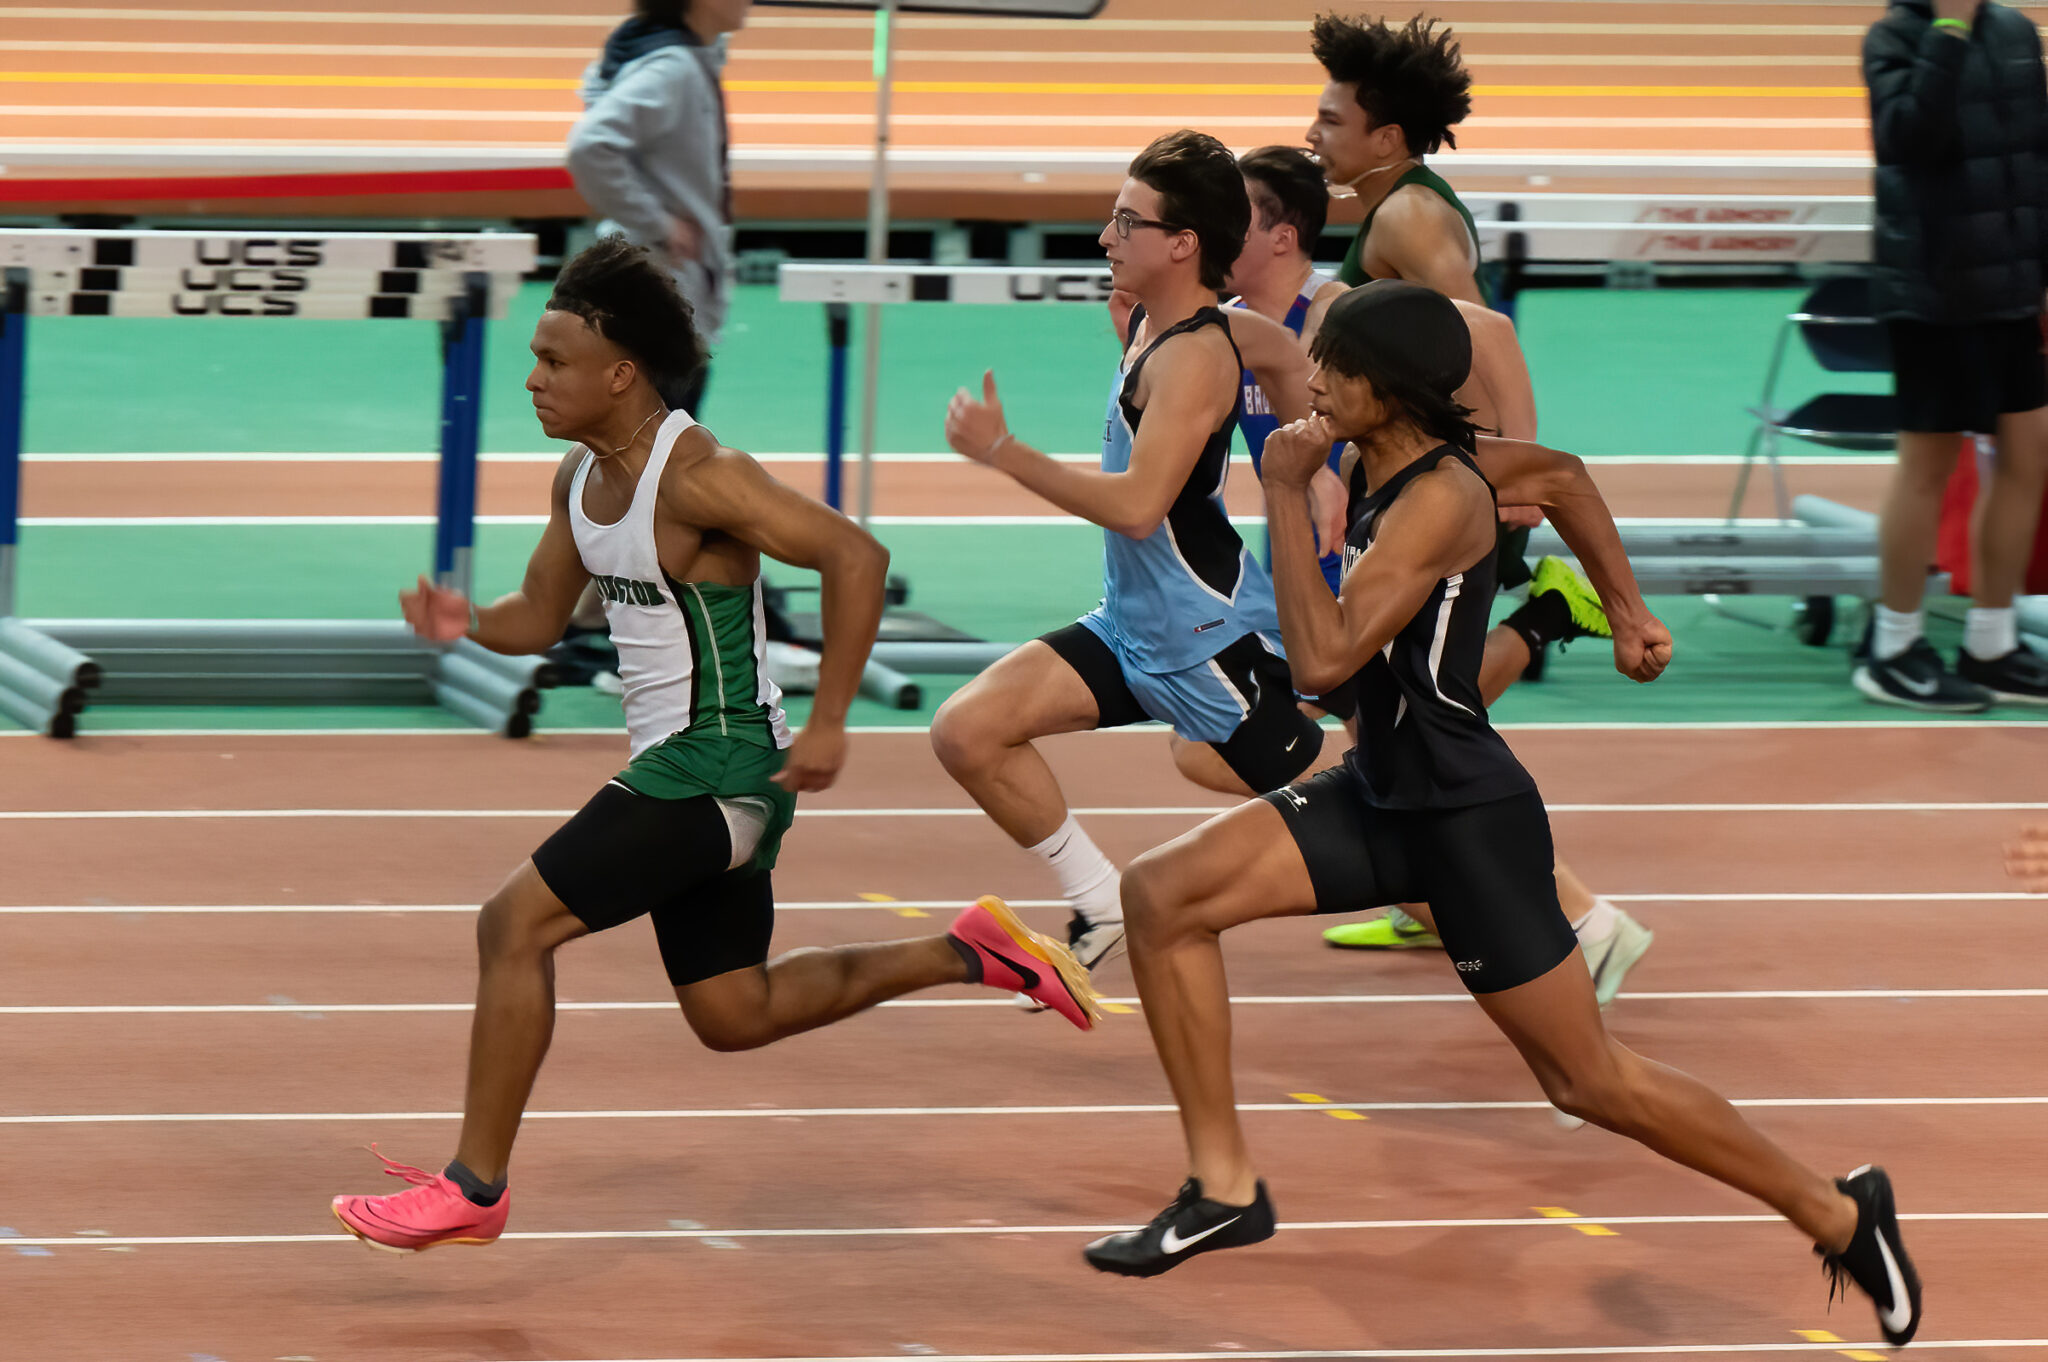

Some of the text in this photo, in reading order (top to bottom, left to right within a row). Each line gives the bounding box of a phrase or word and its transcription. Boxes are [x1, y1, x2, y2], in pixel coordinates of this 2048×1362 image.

[195, 238, 325, 266] UCS
[181, 268, 310, 291] UCS
[172, 294, 299, 316] UCS
